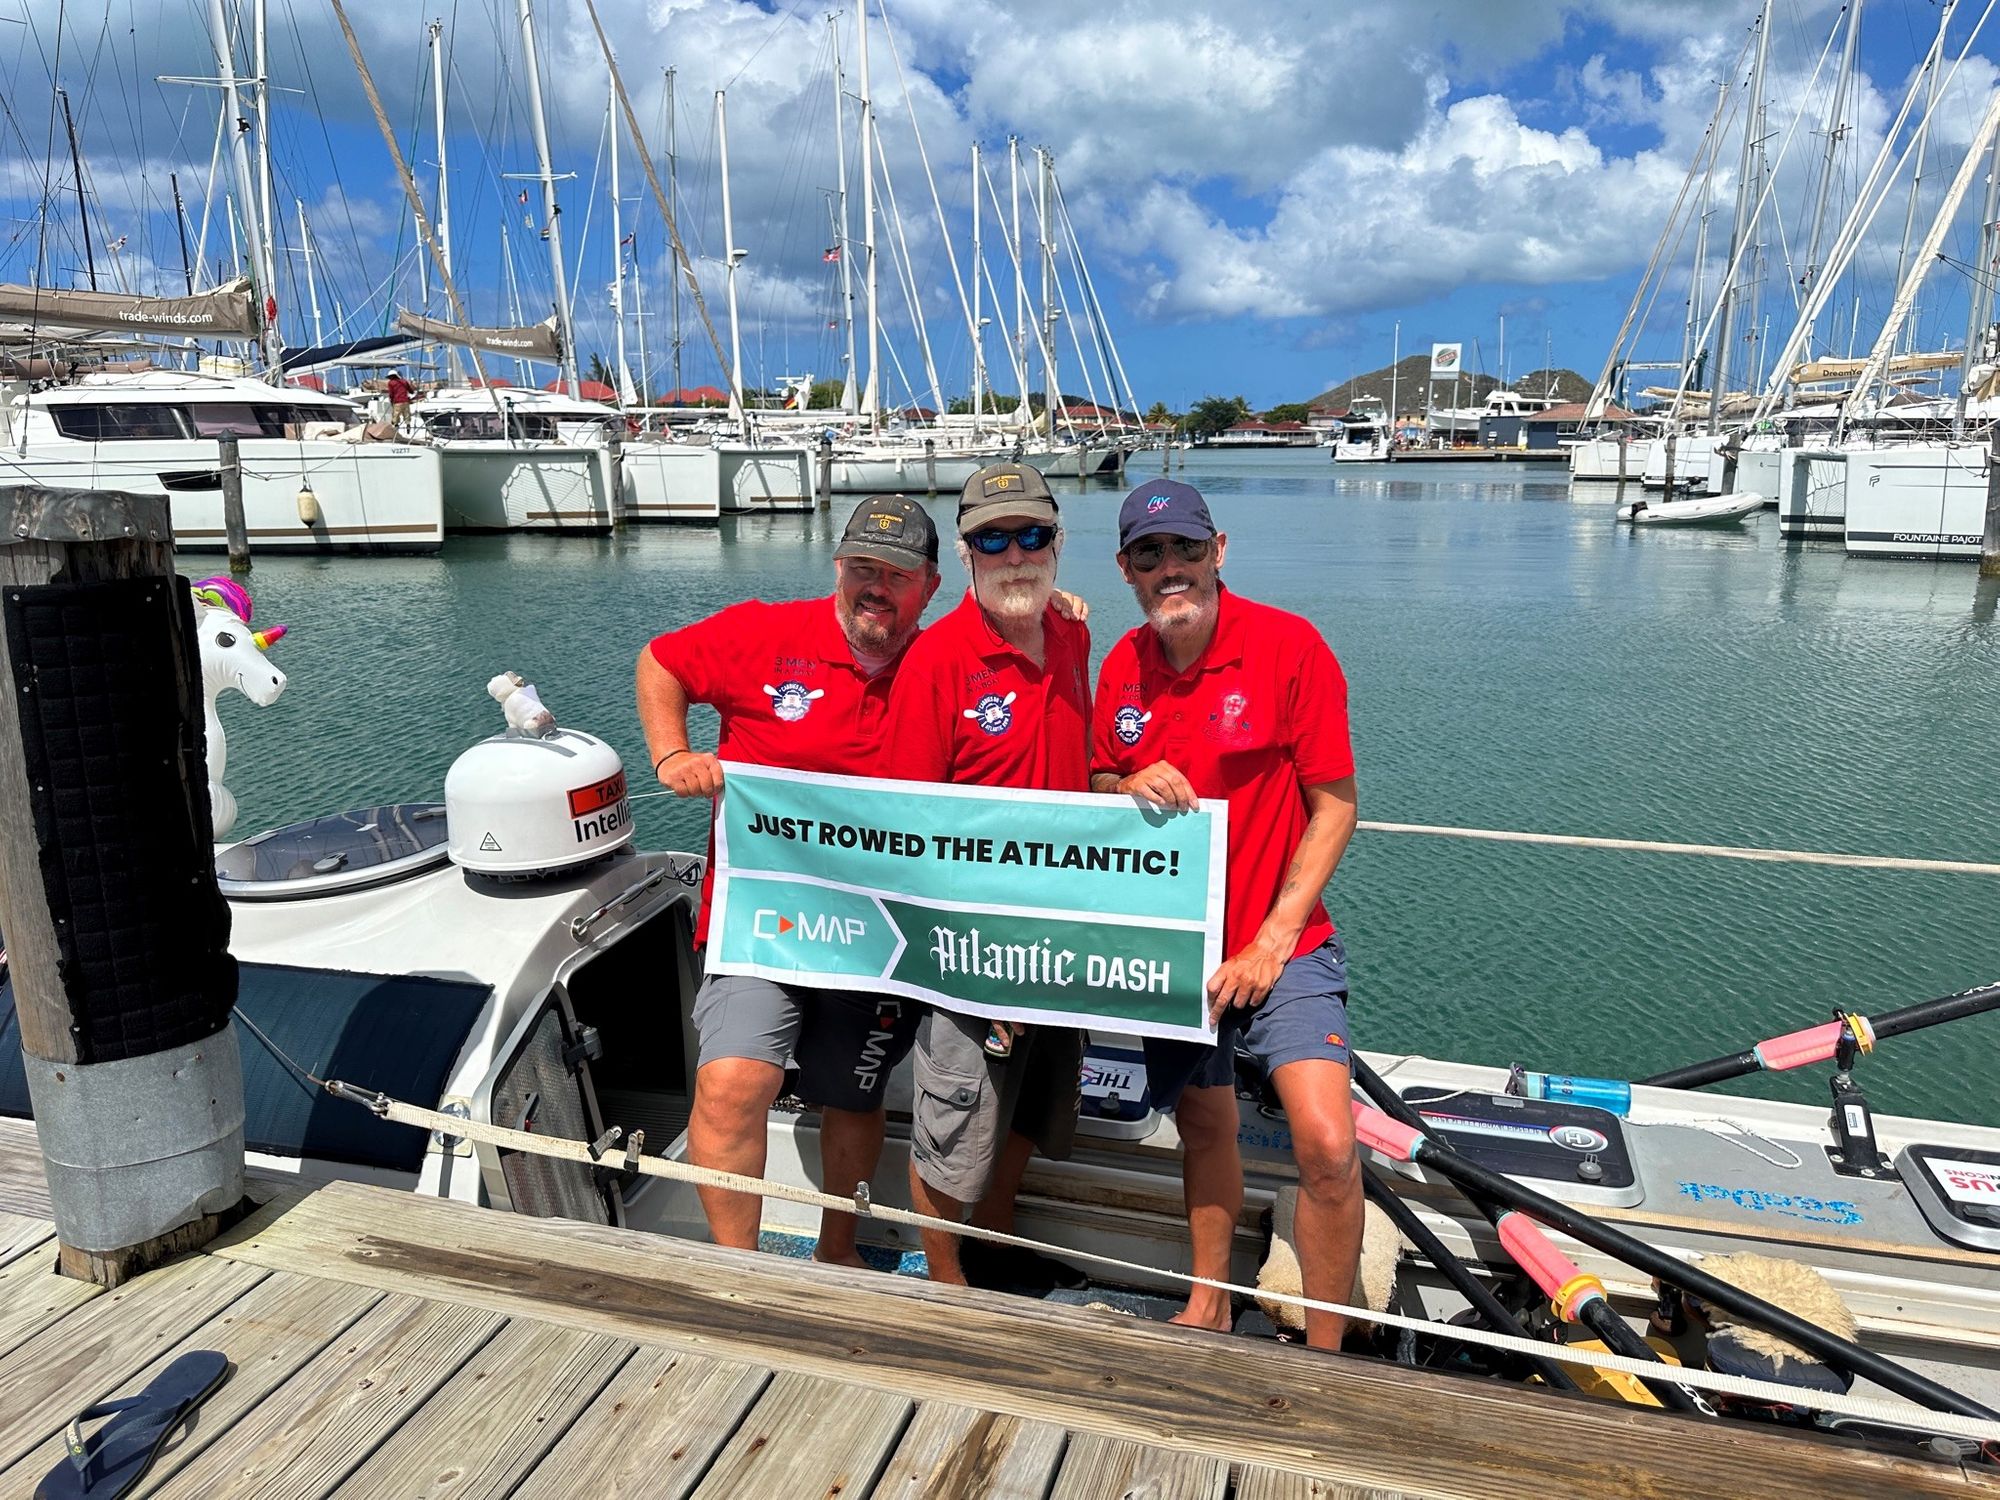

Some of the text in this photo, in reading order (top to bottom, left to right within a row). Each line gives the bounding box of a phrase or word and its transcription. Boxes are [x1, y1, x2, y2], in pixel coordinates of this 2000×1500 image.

[119, 311, 213, 324] trade-winds.com
[486, 337, 533, 347] trade-winds.com
[1893, 533, 1982, 544] FOUNTAINE PAJOT
[595, 777, 624, 802] TAXI
[748, 813, 1179, 877] JUST ROWED THE ATLANTIC!
[928, 925, 1170, 994] Atlantic DASH
[1949, 1177, 2000, 1193] US
